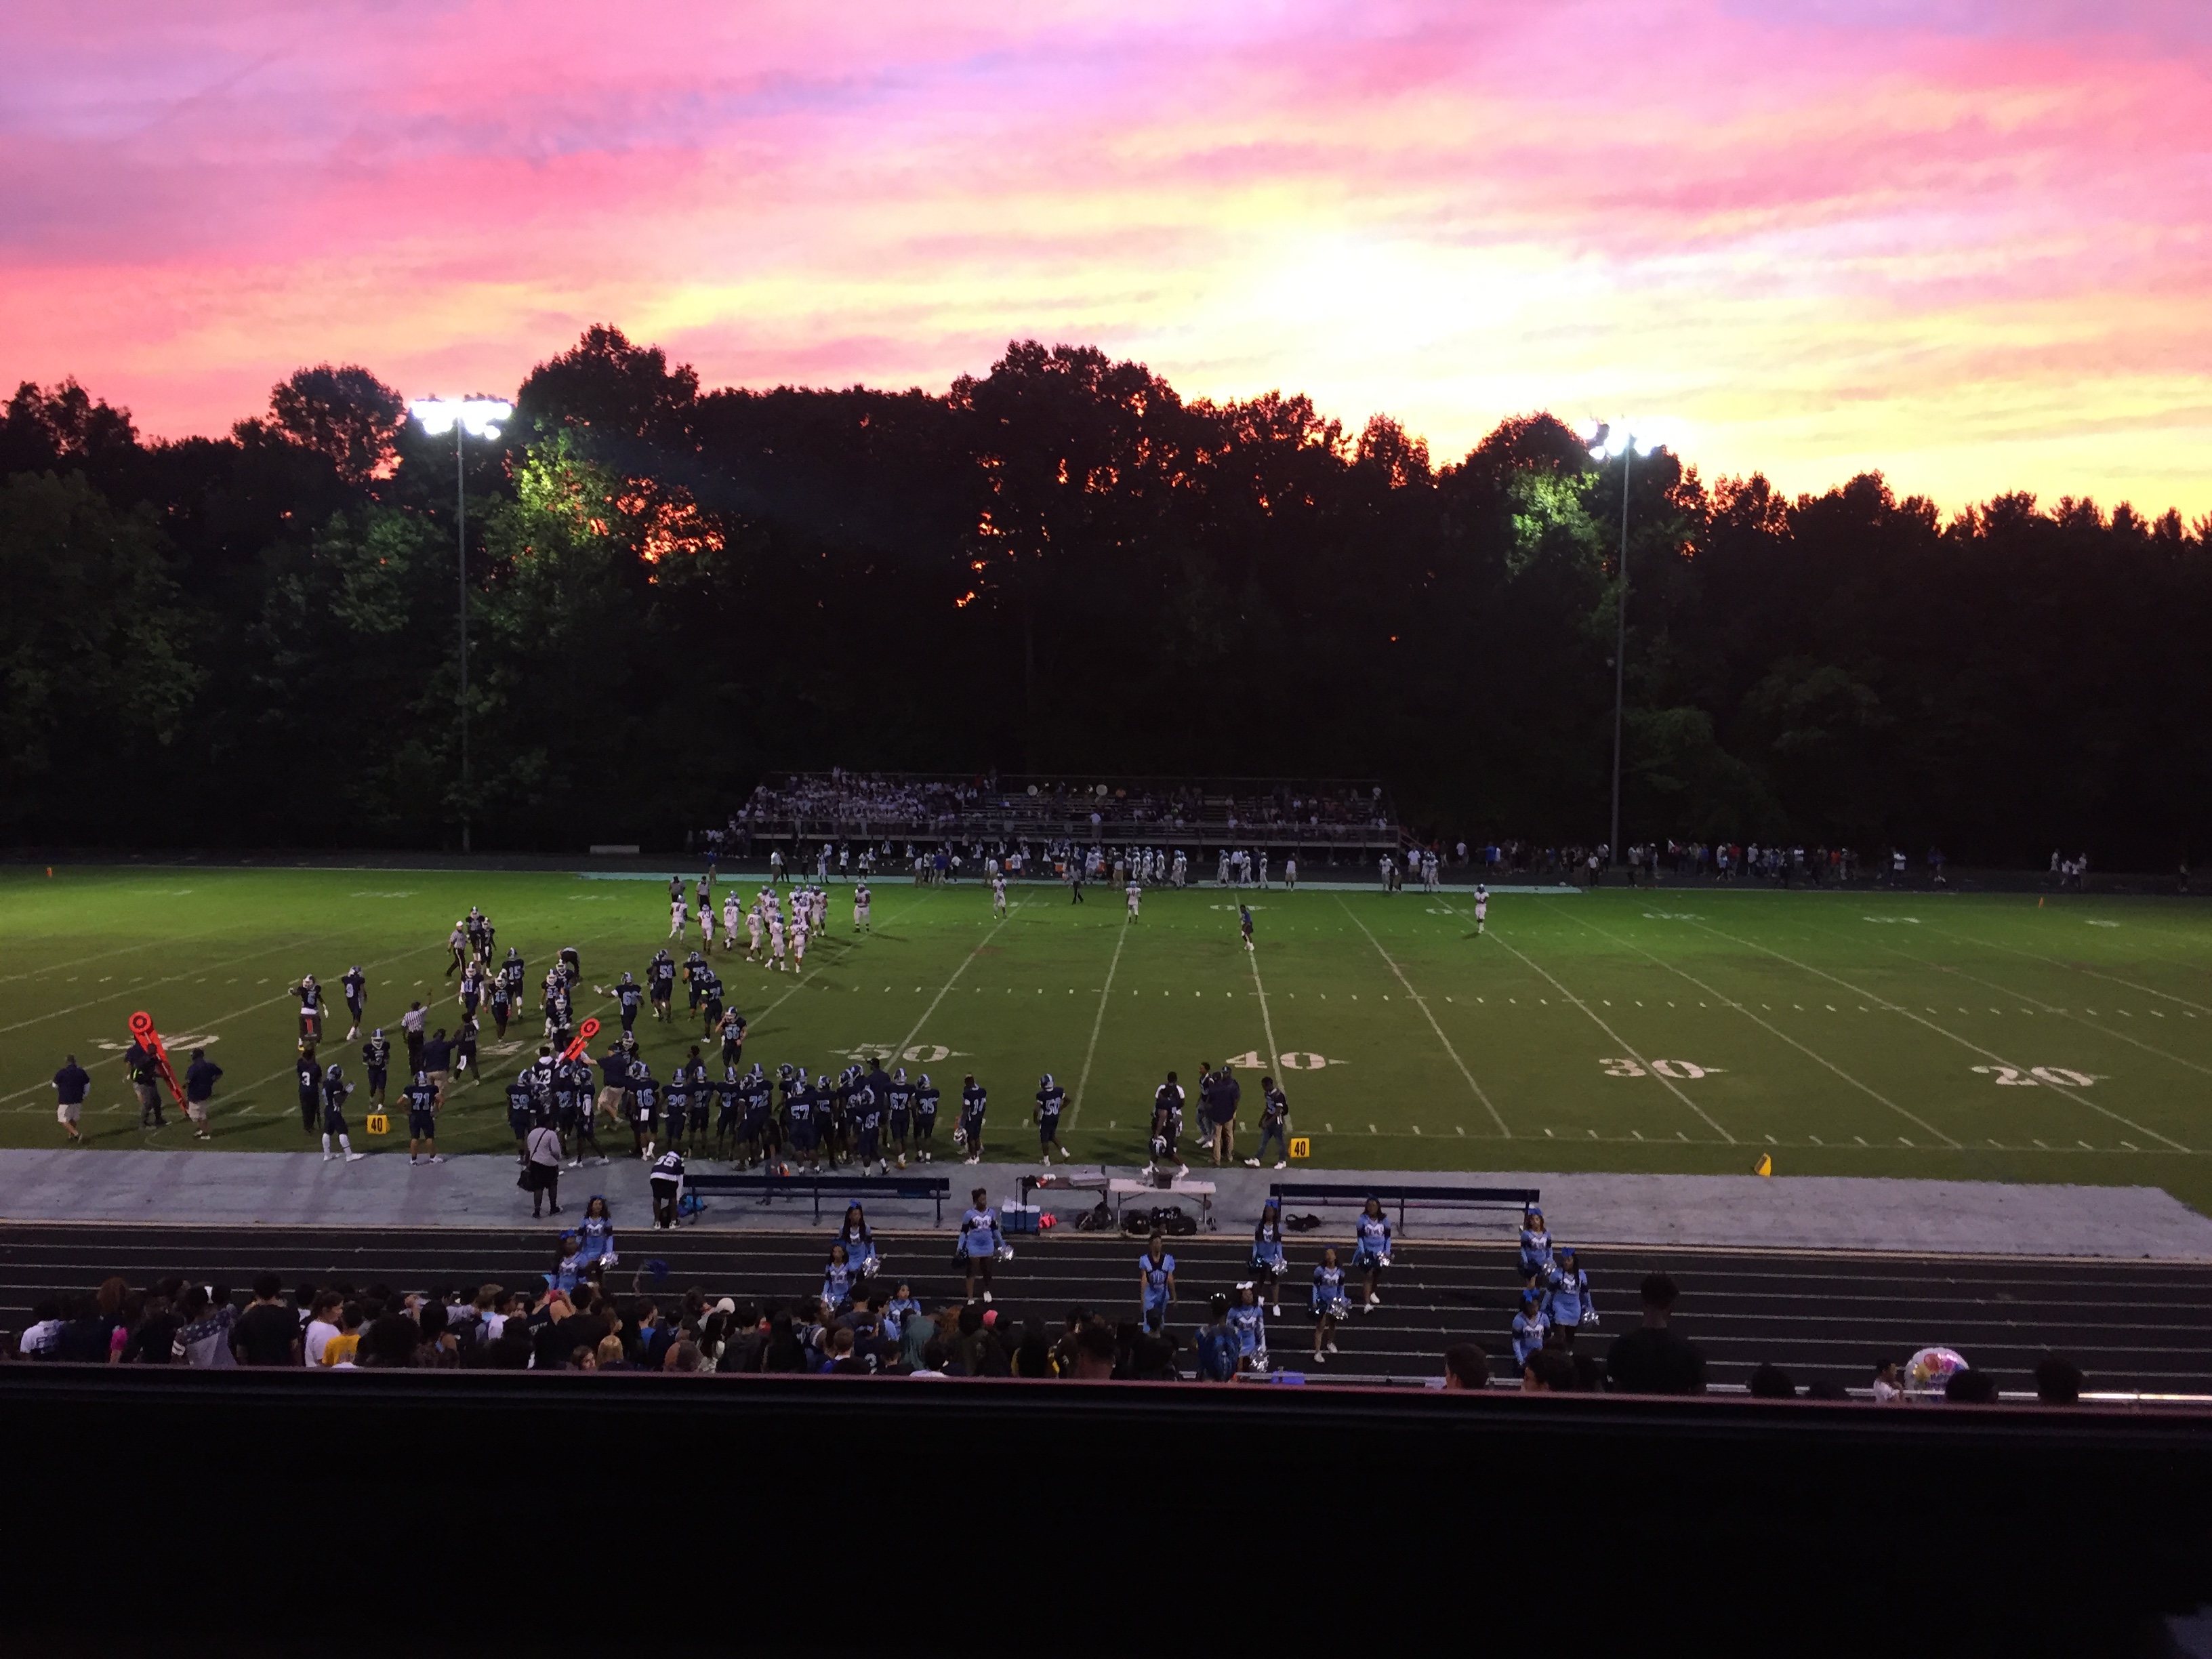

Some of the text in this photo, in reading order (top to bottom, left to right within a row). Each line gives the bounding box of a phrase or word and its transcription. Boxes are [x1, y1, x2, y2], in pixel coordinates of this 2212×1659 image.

[508, 966, 521, 980] 15
[847, 1043, 950, 1063] 50
[1225, 1050, 1326, 1070] 40
[1599, 1058, 1706, 1079] 30
[1971, 1065, 2094, 1086] 20
[302, 1071, 310, 1086] 3
[412, 1092, 430, 1110] 71
[636, 1088, 655, 1107] 16
[890, 1092, 909, 1110] 67
[919, 1097, 939, 1115] 35
[790, 1104, 810, 1120] 57
[371, 1118, 383, 1132] 40
[1294, 1141, 1306, 1156] 40
